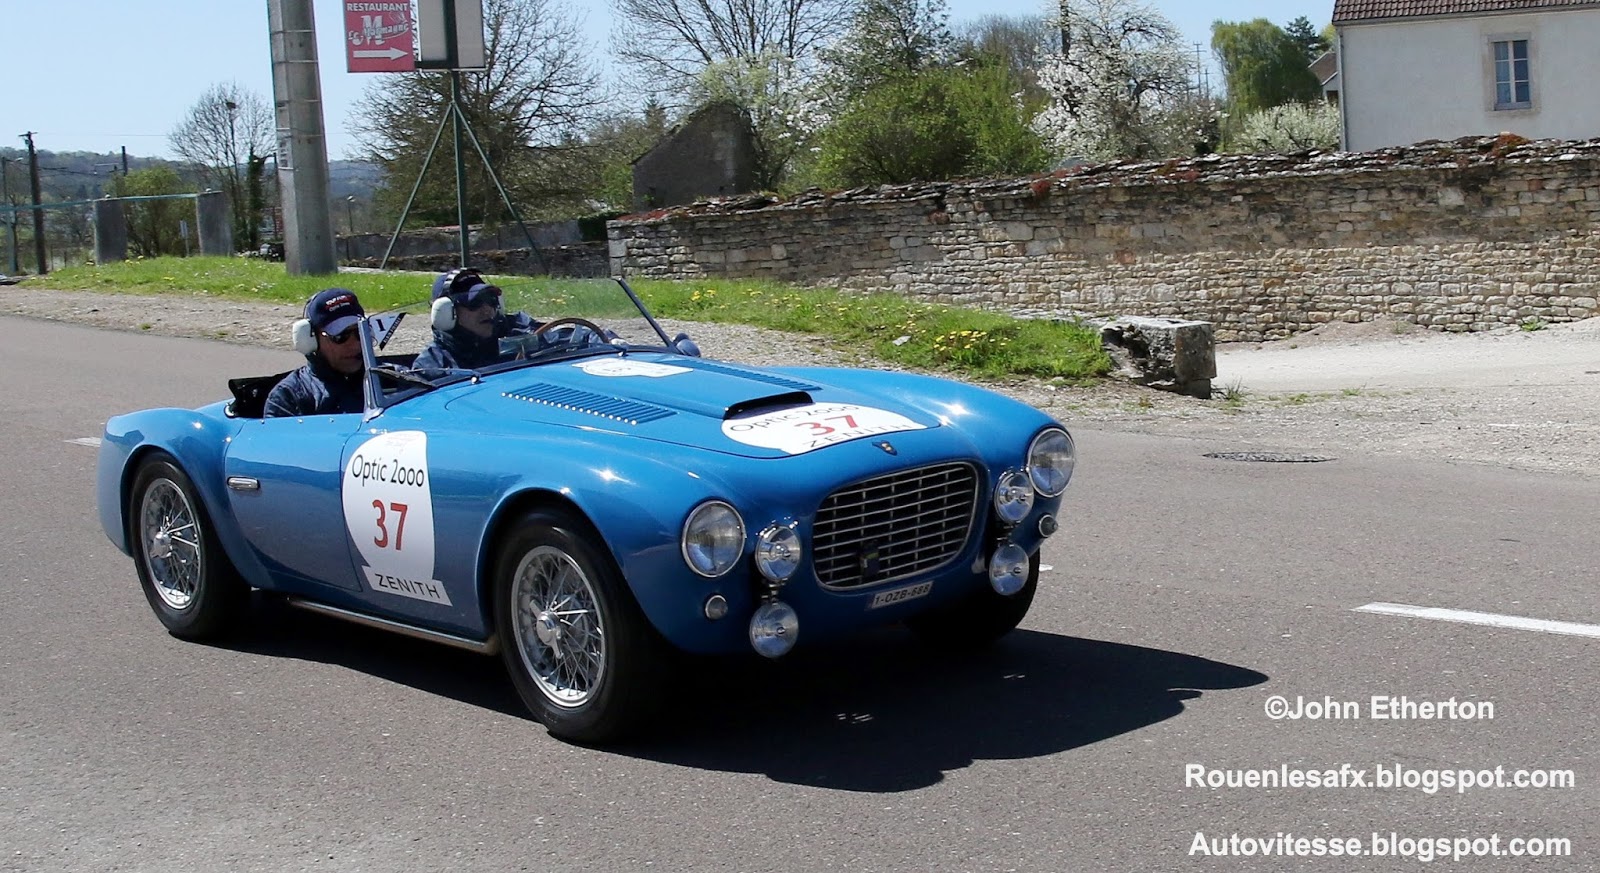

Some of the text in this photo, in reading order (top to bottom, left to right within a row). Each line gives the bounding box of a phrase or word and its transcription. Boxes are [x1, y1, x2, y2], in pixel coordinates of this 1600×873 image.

[347, 3, 408, 12] RESTAURANT
[730, 405, 860, 432] Optic 2000
[794, 414, 859, 436] 37
[802, 424, 913, 448] ZENITH
[352, 454, 425, 488] Optic 2000
[372, 499, 408, 551] 37
[374, 573, 441, 599] ZENITH
